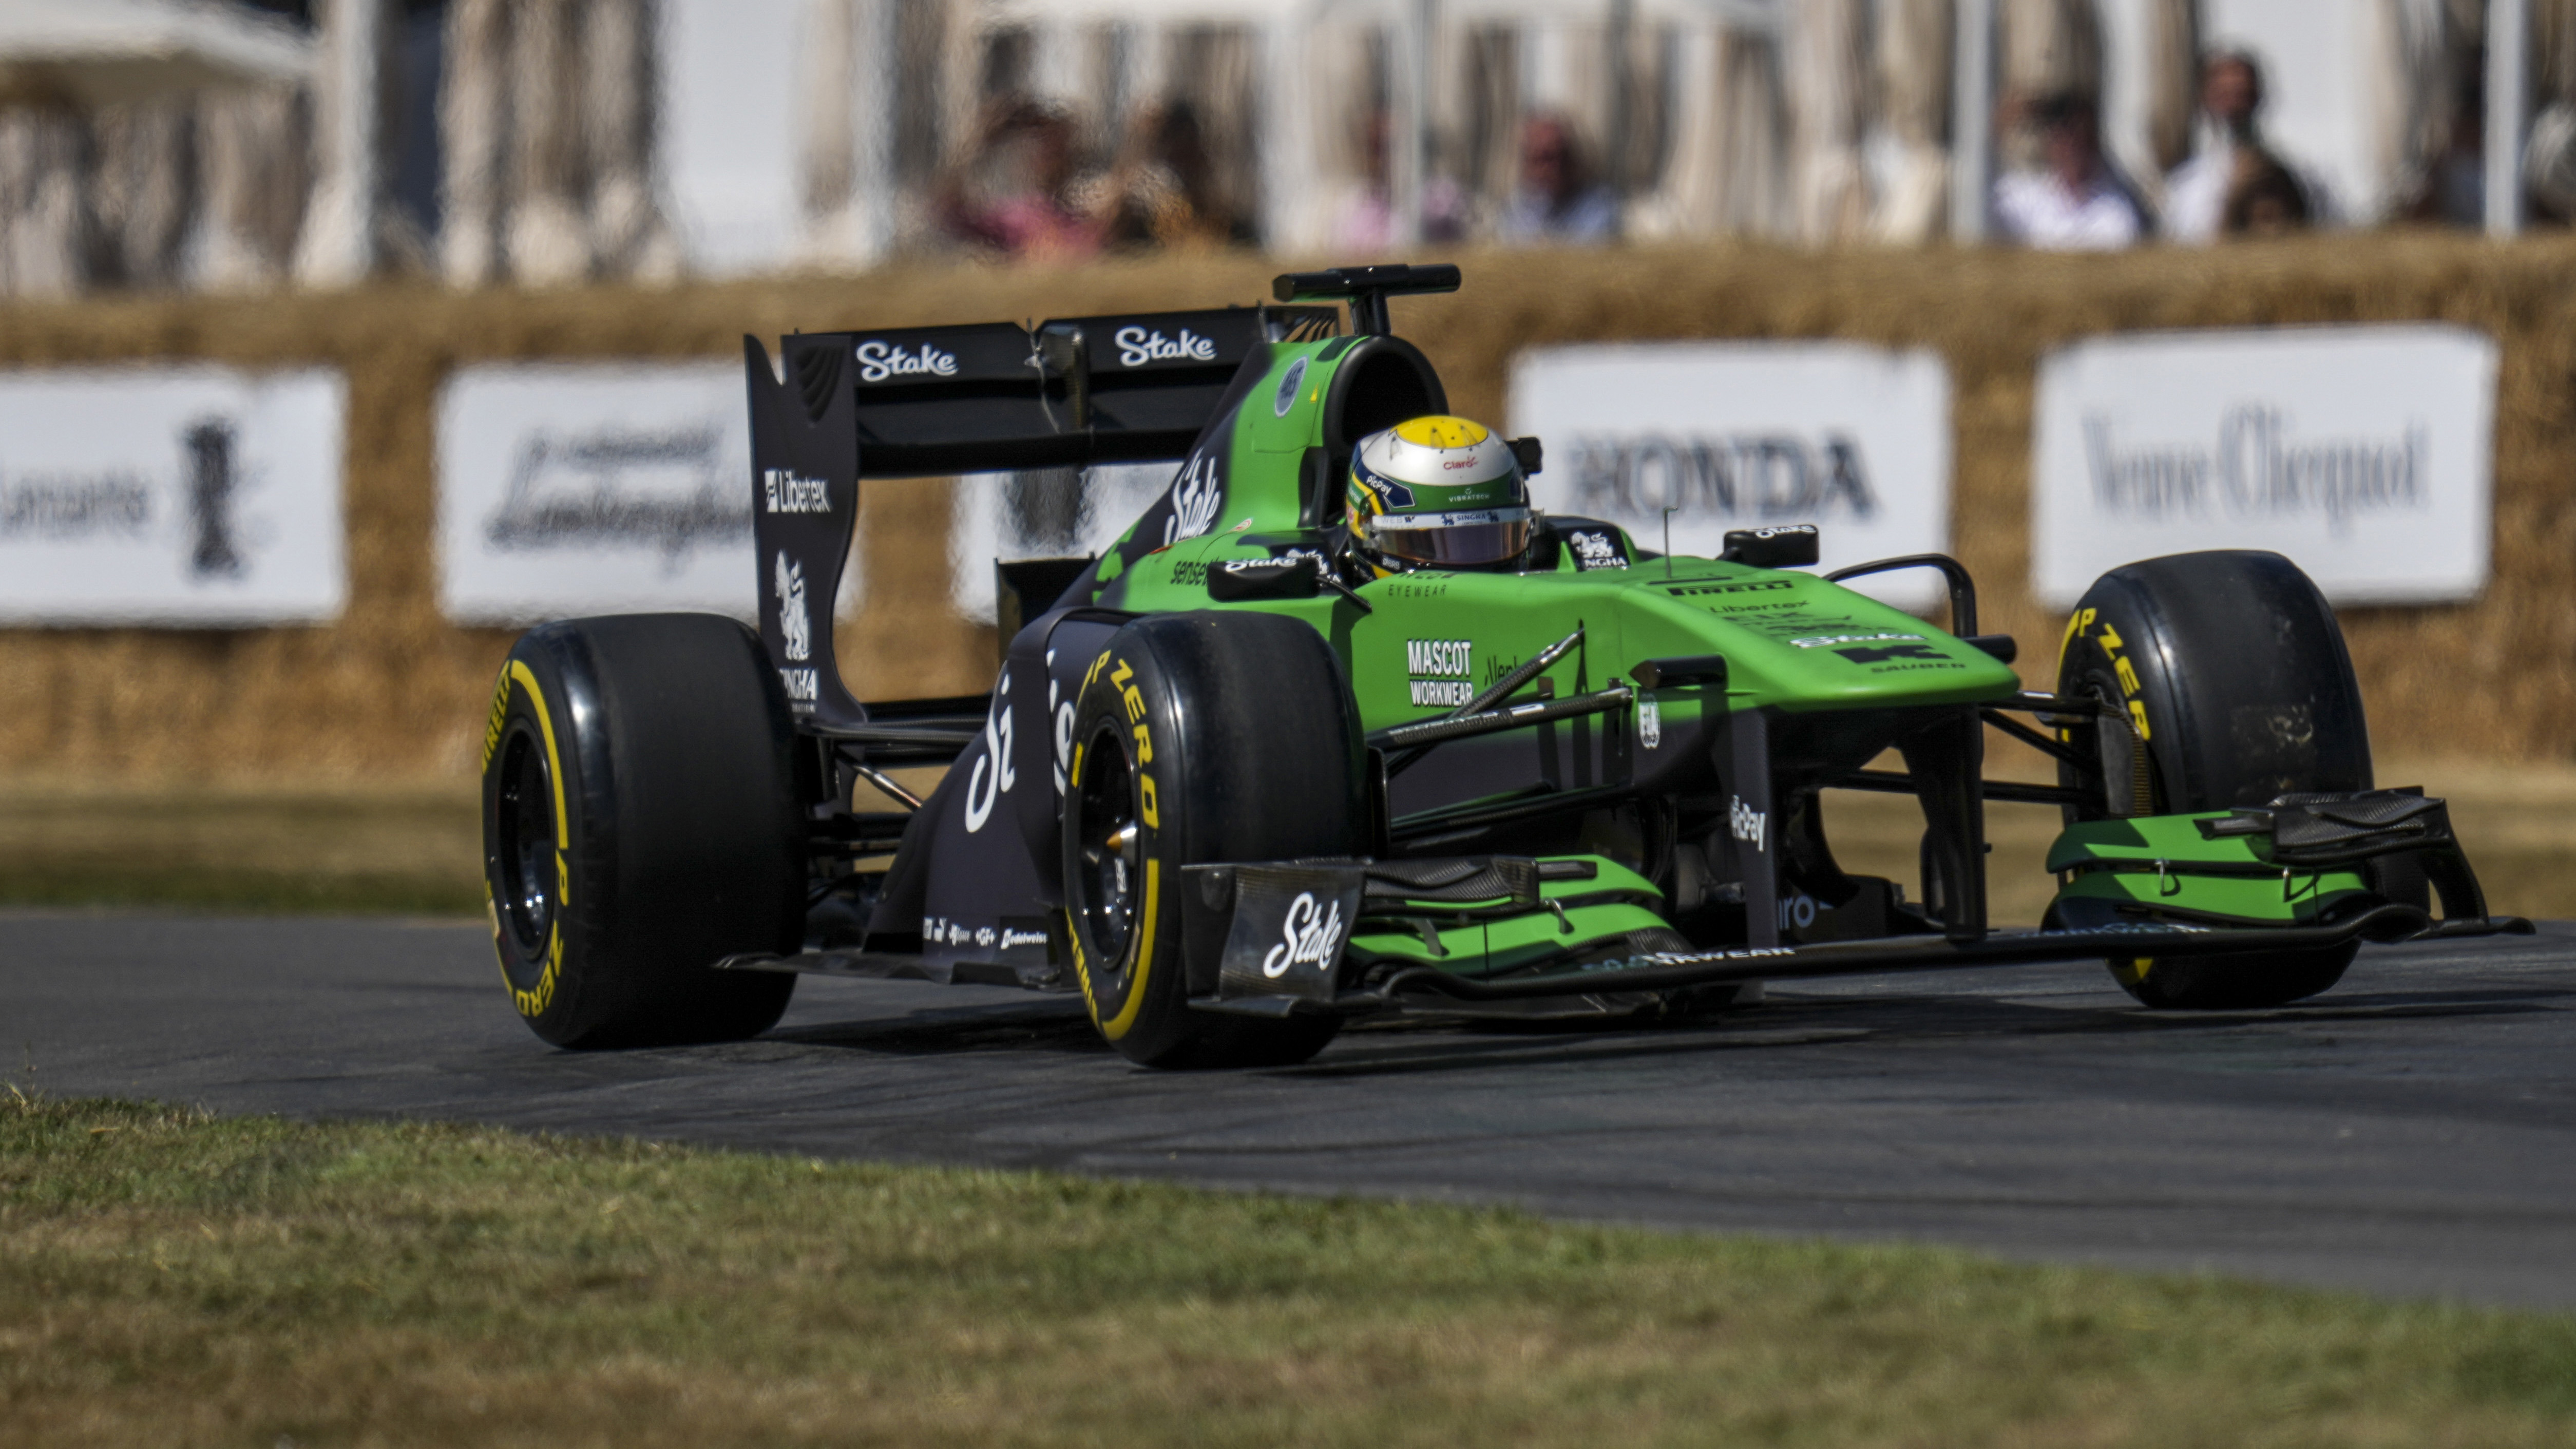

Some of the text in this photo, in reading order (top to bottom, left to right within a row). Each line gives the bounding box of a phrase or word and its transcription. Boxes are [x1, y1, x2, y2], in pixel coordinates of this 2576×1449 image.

[856, 341, 958, 382] Stake
[1115, 326, 1215, 366] Stake
[778, 470, 831, 513] Libertex
[1163, 446, 1221, 547] Stake
[1366, 474, 1392, 496] PicPay
[1388, 584, 1447, 597] EYEWEAR
[1667, 580, 1793, 596] PIRELLI
[1709, 600, 1809, 614] Libertex
[1407, 640, 1471, 677] MASCOT
[1410, 680, 1474, 707] WORKWEAR
[2098, 623, 2151, 741] ZER
[1110, 659, 1159, 830] ZERO
[1263, 891, 1342, 979] Stake
[515, 918, 564, 1018] ZERO
